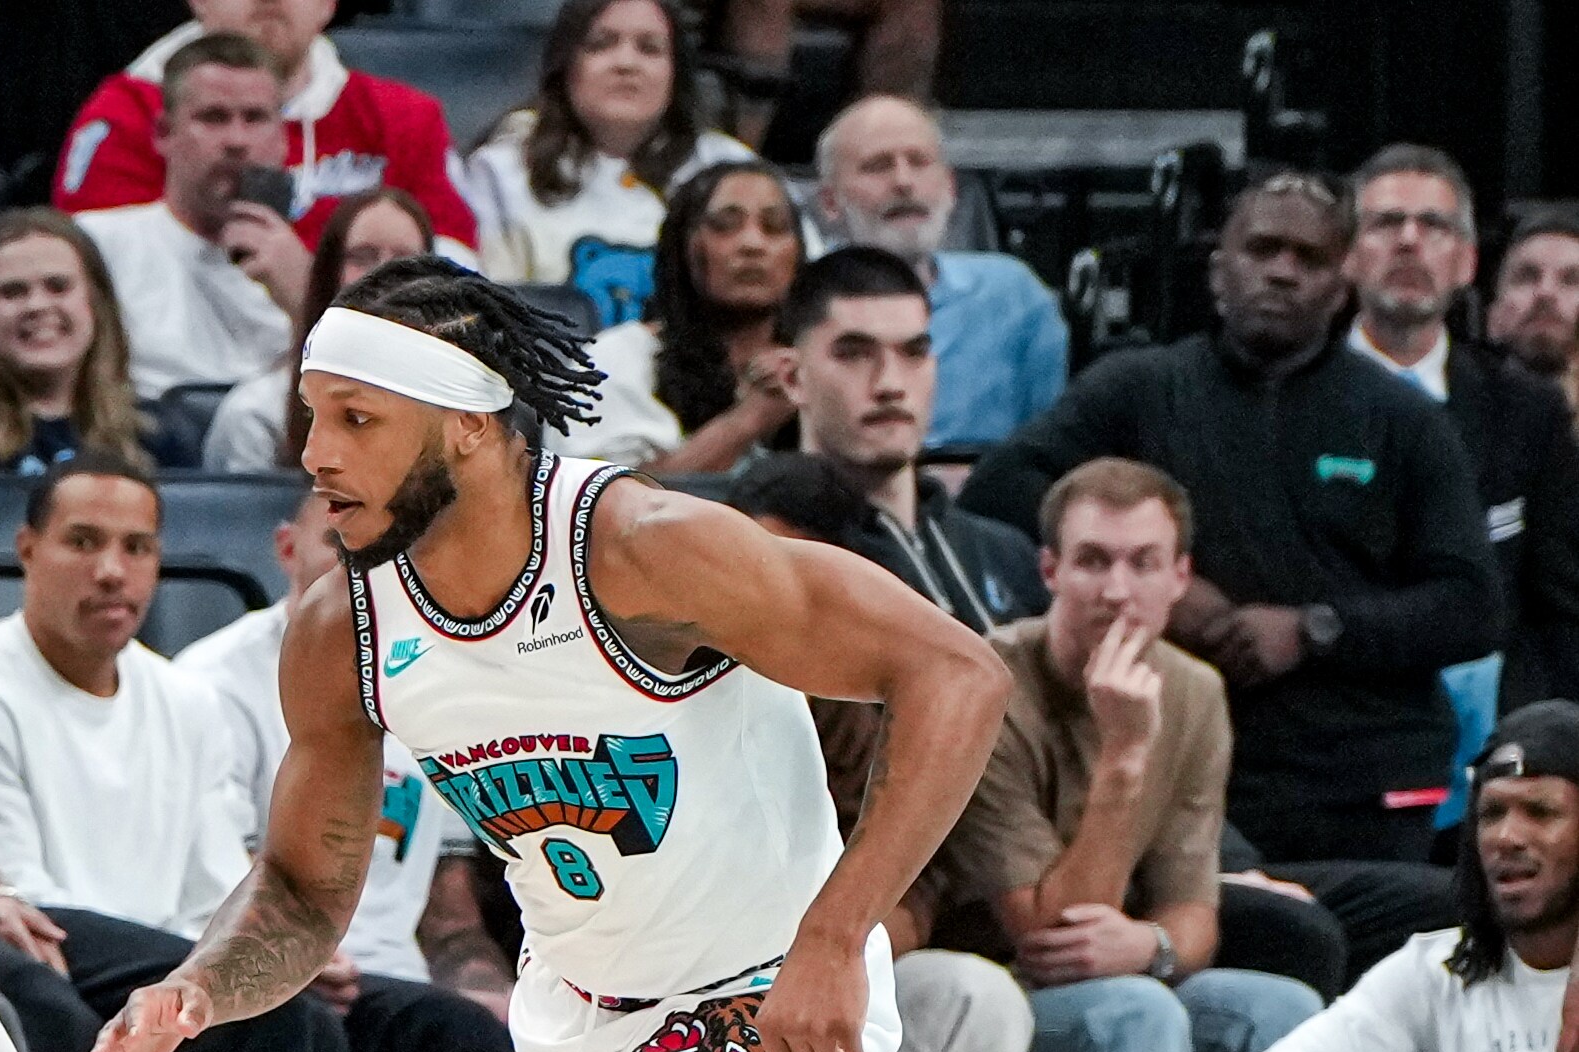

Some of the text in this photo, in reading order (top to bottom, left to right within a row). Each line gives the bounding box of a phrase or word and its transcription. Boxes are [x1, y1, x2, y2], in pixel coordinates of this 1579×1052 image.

[517, 625, 584, 654] Robinhood
[438, 734, 593, 769] VANCOUVER
[539, 837, 605, 901] 8
